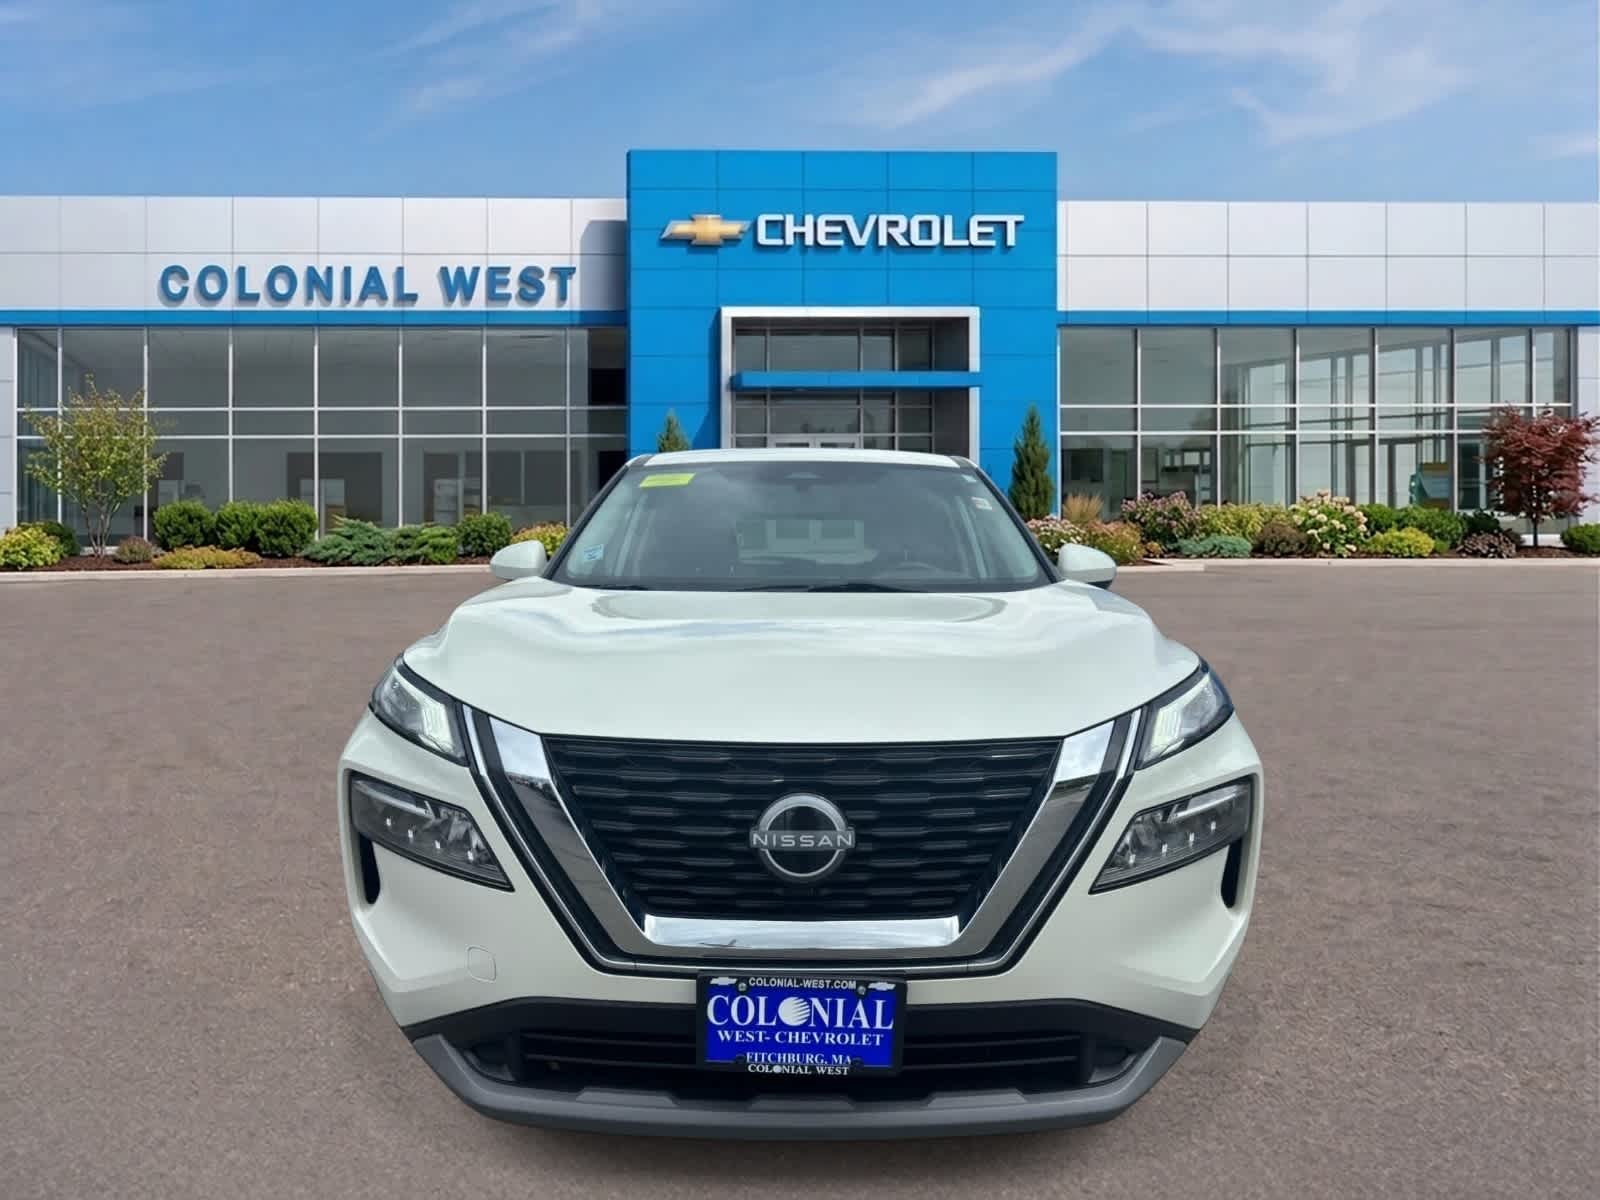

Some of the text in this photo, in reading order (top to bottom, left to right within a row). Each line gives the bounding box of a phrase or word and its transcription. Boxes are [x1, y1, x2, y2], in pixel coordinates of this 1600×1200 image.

[757, 213, 1025, 247] CHEVROLET
[159, 264, 577, 304] COLONIAL WEST
[752, 833, 852, 848] NISSAN
[748, 977, 857, 990] COLONIAL-WEST.COM
[707, 994, 894, 1030] COLONIAL
[774, 1031, 884, 1046] CHEVROLET
[831, 1054, 852, 1065] MA
[747, 1064, 850, 1076] COLONIAL WEST
